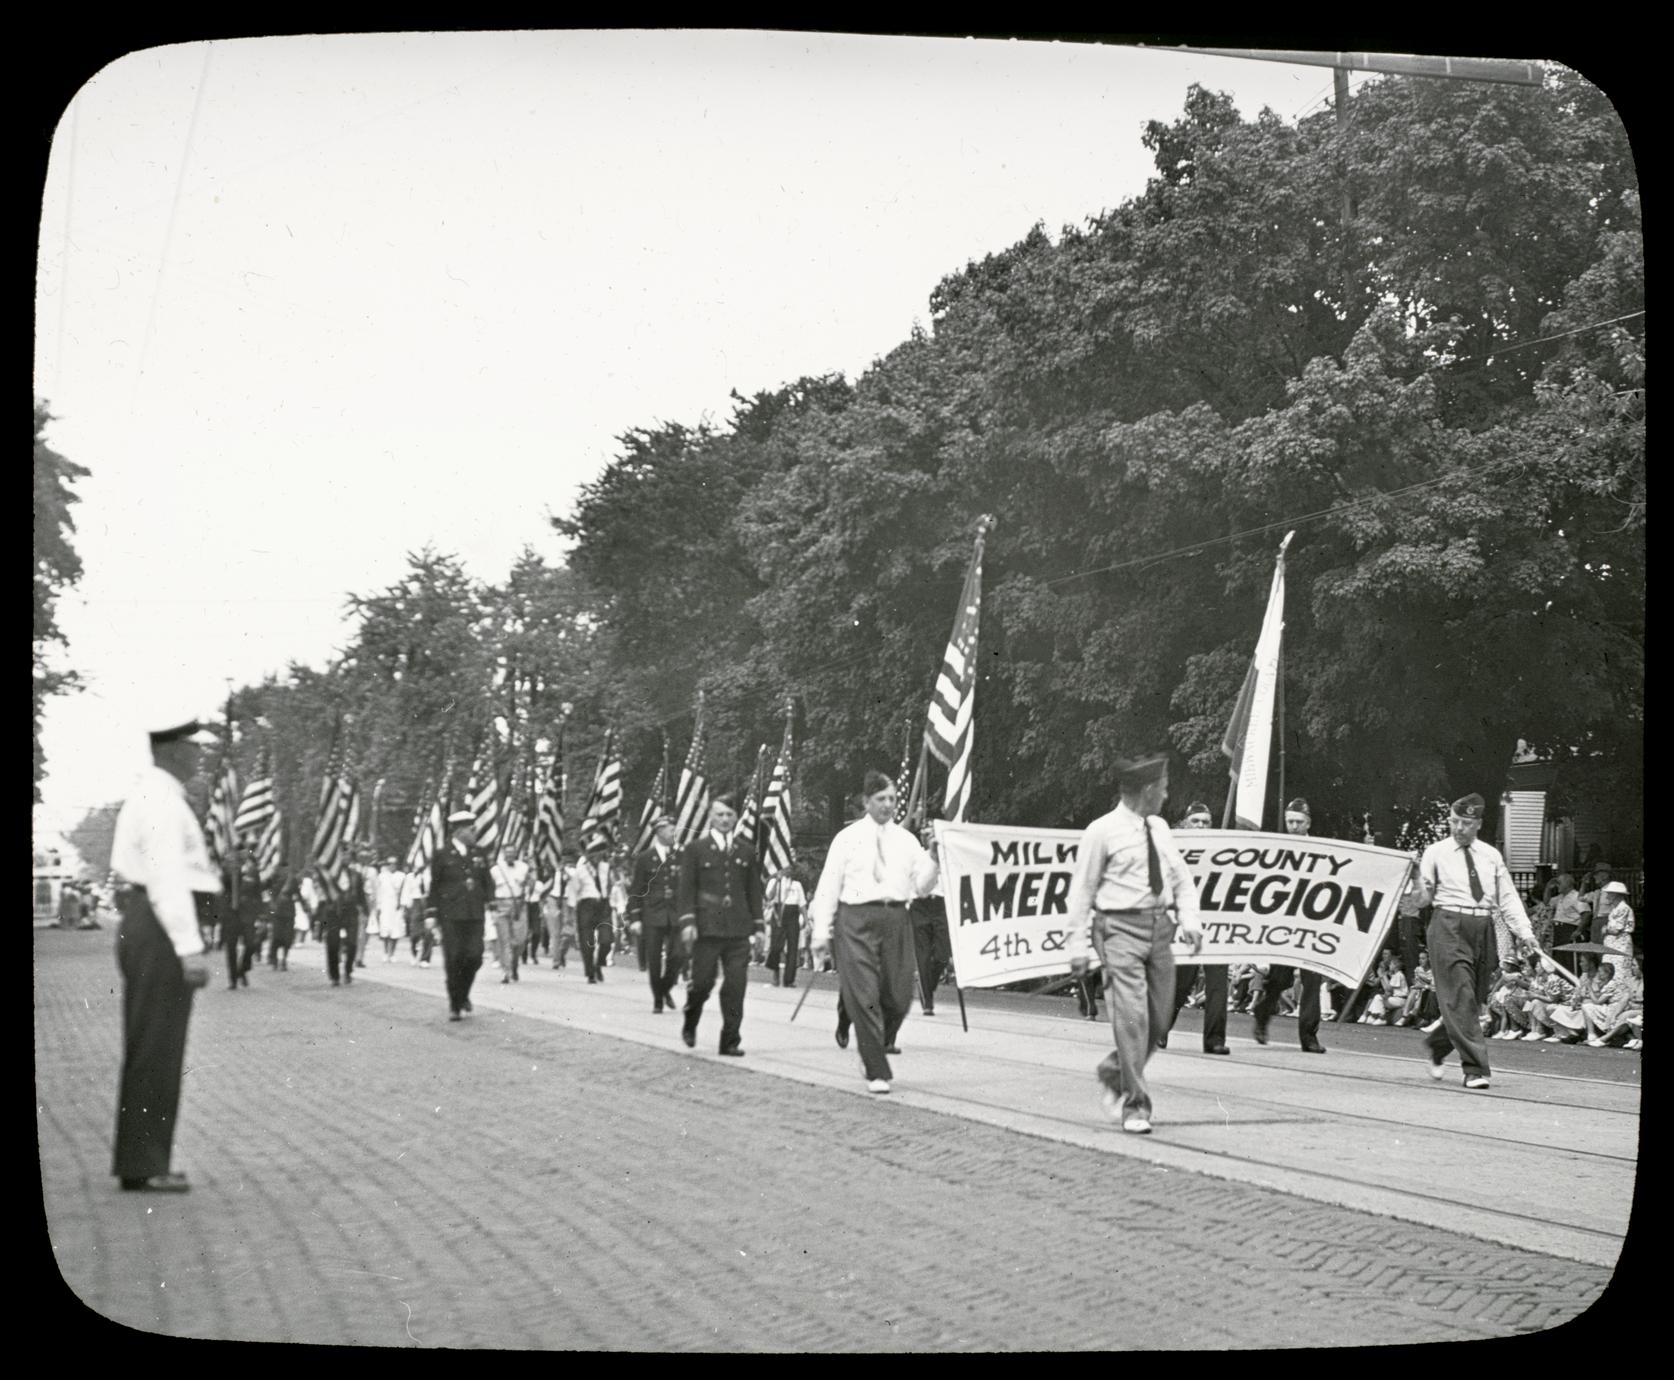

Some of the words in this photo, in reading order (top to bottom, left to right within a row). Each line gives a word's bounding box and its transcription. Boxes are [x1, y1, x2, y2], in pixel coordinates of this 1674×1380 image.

[990, 840, 1206, 867] MILWE
[1210, 848, 1354, 876] COUNTY
[1199, 871, 1385, 934] LEGION
[980, 932, 1032, 960] 4th
[1041, 930, 1076, 952] &
[1169, 922, 1341, 955] TRICTS
